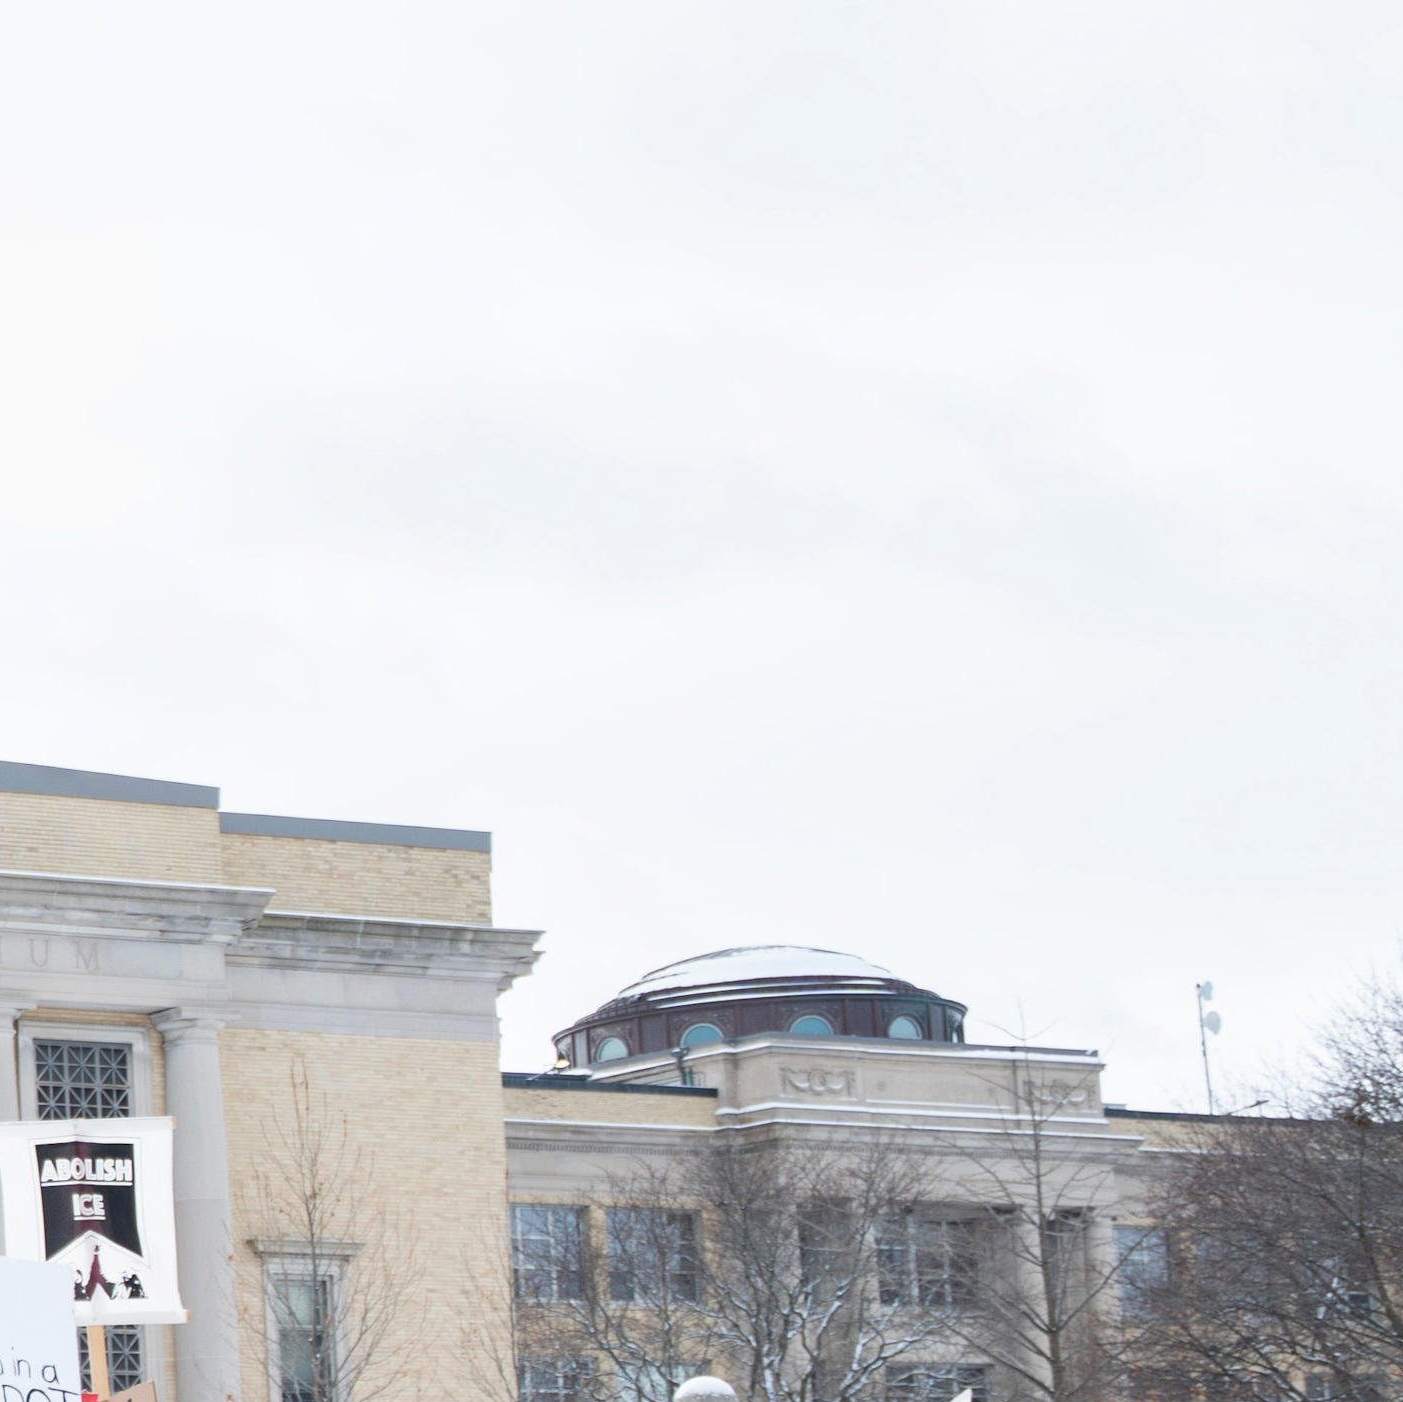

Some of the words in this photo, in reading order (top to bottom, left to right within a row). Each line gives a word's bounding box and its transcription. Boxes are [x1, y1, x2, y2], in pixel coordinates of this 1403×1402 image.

[40, 1157, 134, 1183] ABOLISH
[71, 1193, 106, 1217] ICE
[11, 1346, 31, 1379] in
[42, 1364, 59, 1384] a
